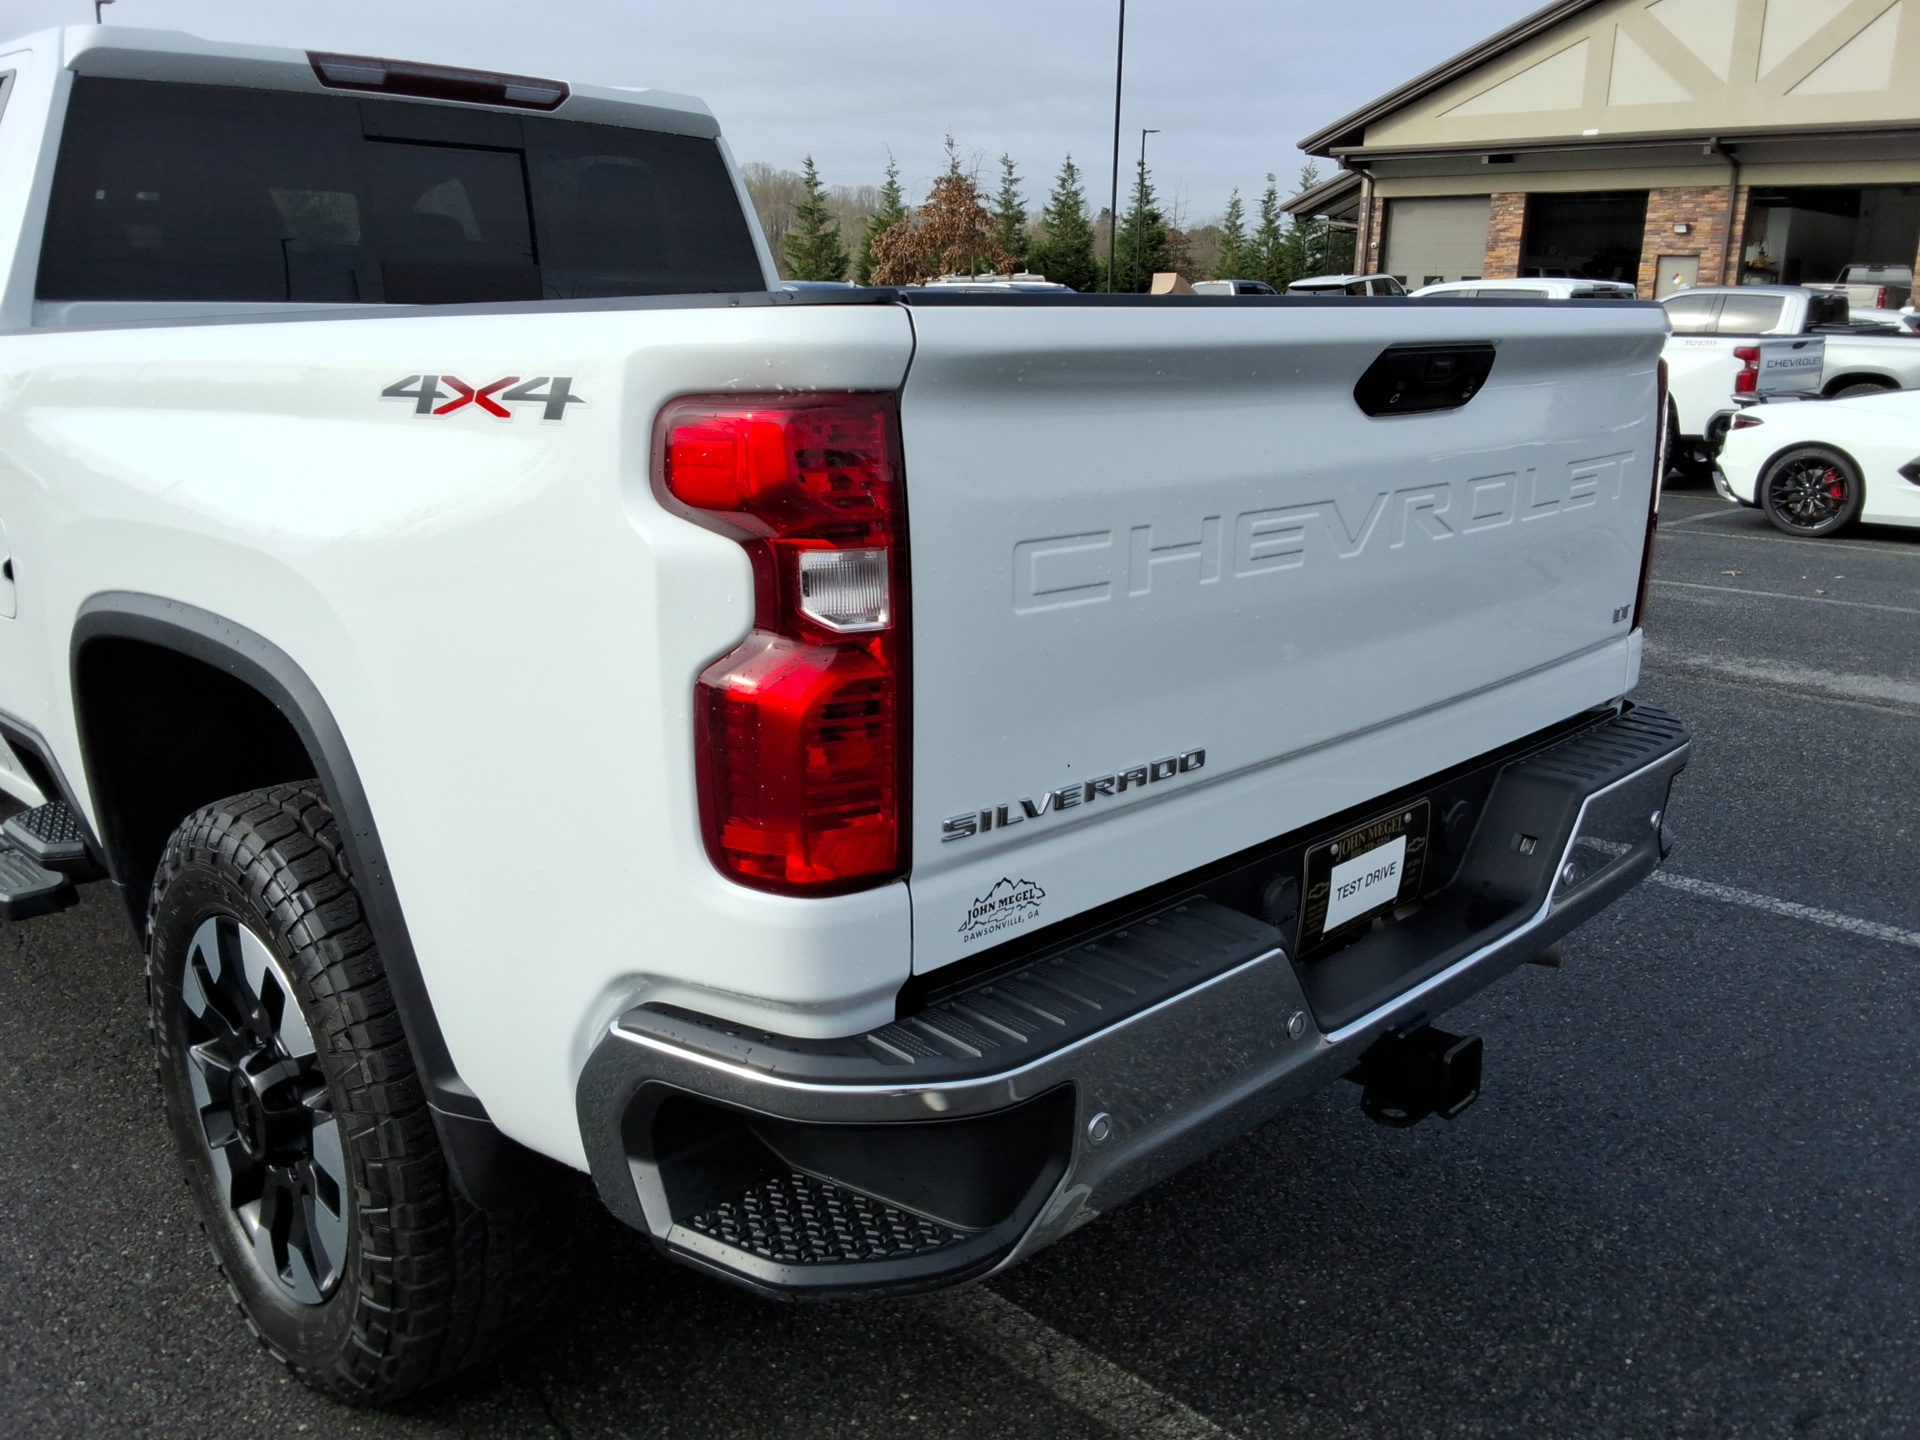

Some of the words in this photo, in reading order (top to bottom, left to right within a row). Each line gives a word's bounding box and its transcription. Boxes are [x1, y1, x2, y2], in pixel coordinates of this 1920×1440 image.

[1767, 357, 1822, 368] CHEVROLET
[1013, 450, 1635, 615] CHEVROLET
[1612, 603, 1631, 623] LT
[941, 747, 1206, 843] SILVERADO
[1336, 833, 1366, 862] JOHN
[1368, 815, 1404, 839] MEGEL
[1337, 877, 1363, 901] TEST
[1365, 861, 1397, 888] DRIVE
[967, 900, 996, 925] JOHN
[998, 888, 1036, 910] MEGEL
[963, 915, 1025, 943] DAWSONVILLE,
[1027, 909, 1040, 920] GA
